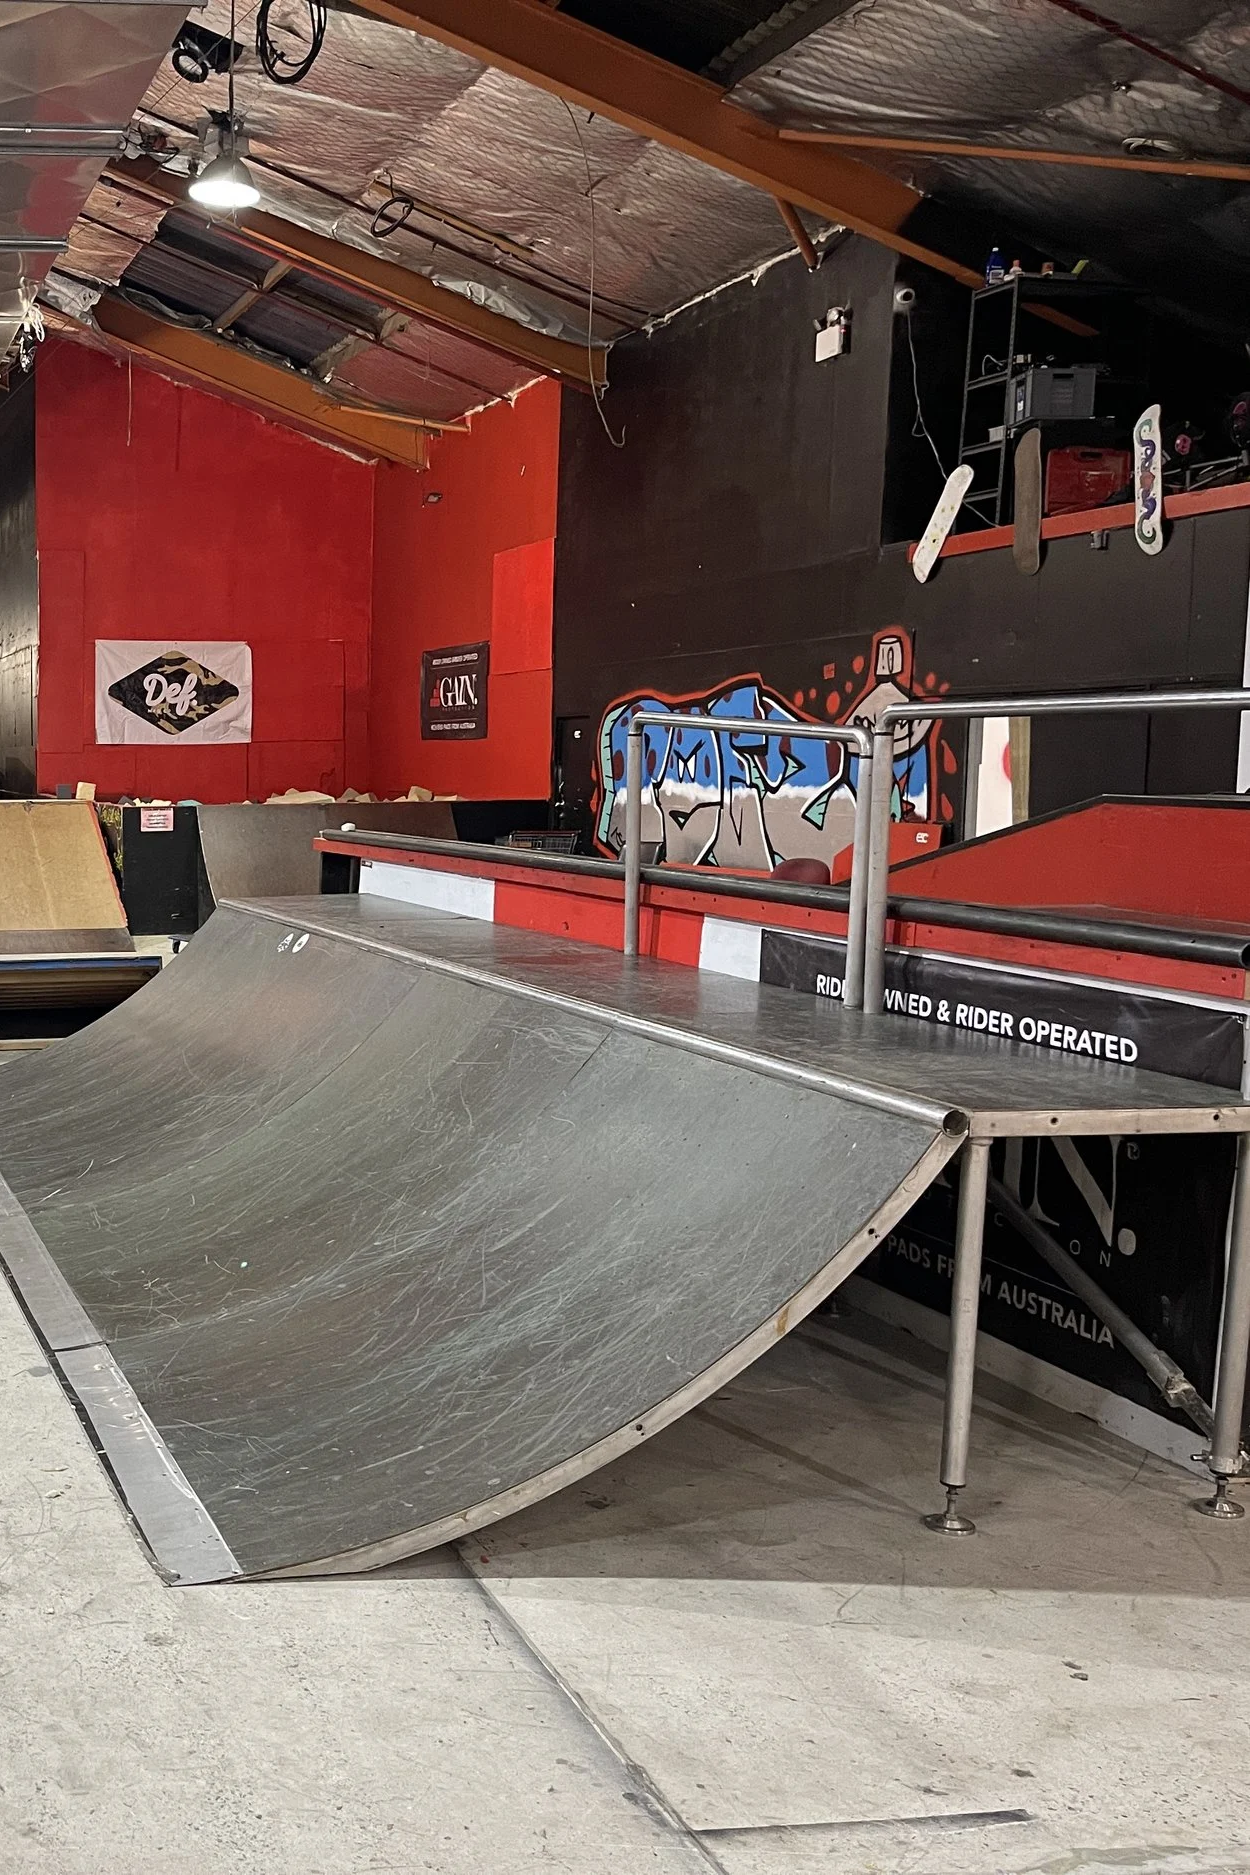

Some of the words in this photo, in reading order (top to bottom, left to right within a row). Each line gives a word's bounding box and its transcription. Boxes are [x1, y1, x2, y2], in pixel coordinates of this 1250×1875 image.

[143, 673, 198, 716] Def.
[816, 974, 846, 999] RID
[883, 988, 932, 1018] WNED
[936, 999, 951, 1023] &
[955, 1003, 1015, 1037] RIDER
[1018, 1016, 1139, 1063] OPERATED
[998, 1281, 1115, 1350] AUSTRALIA
